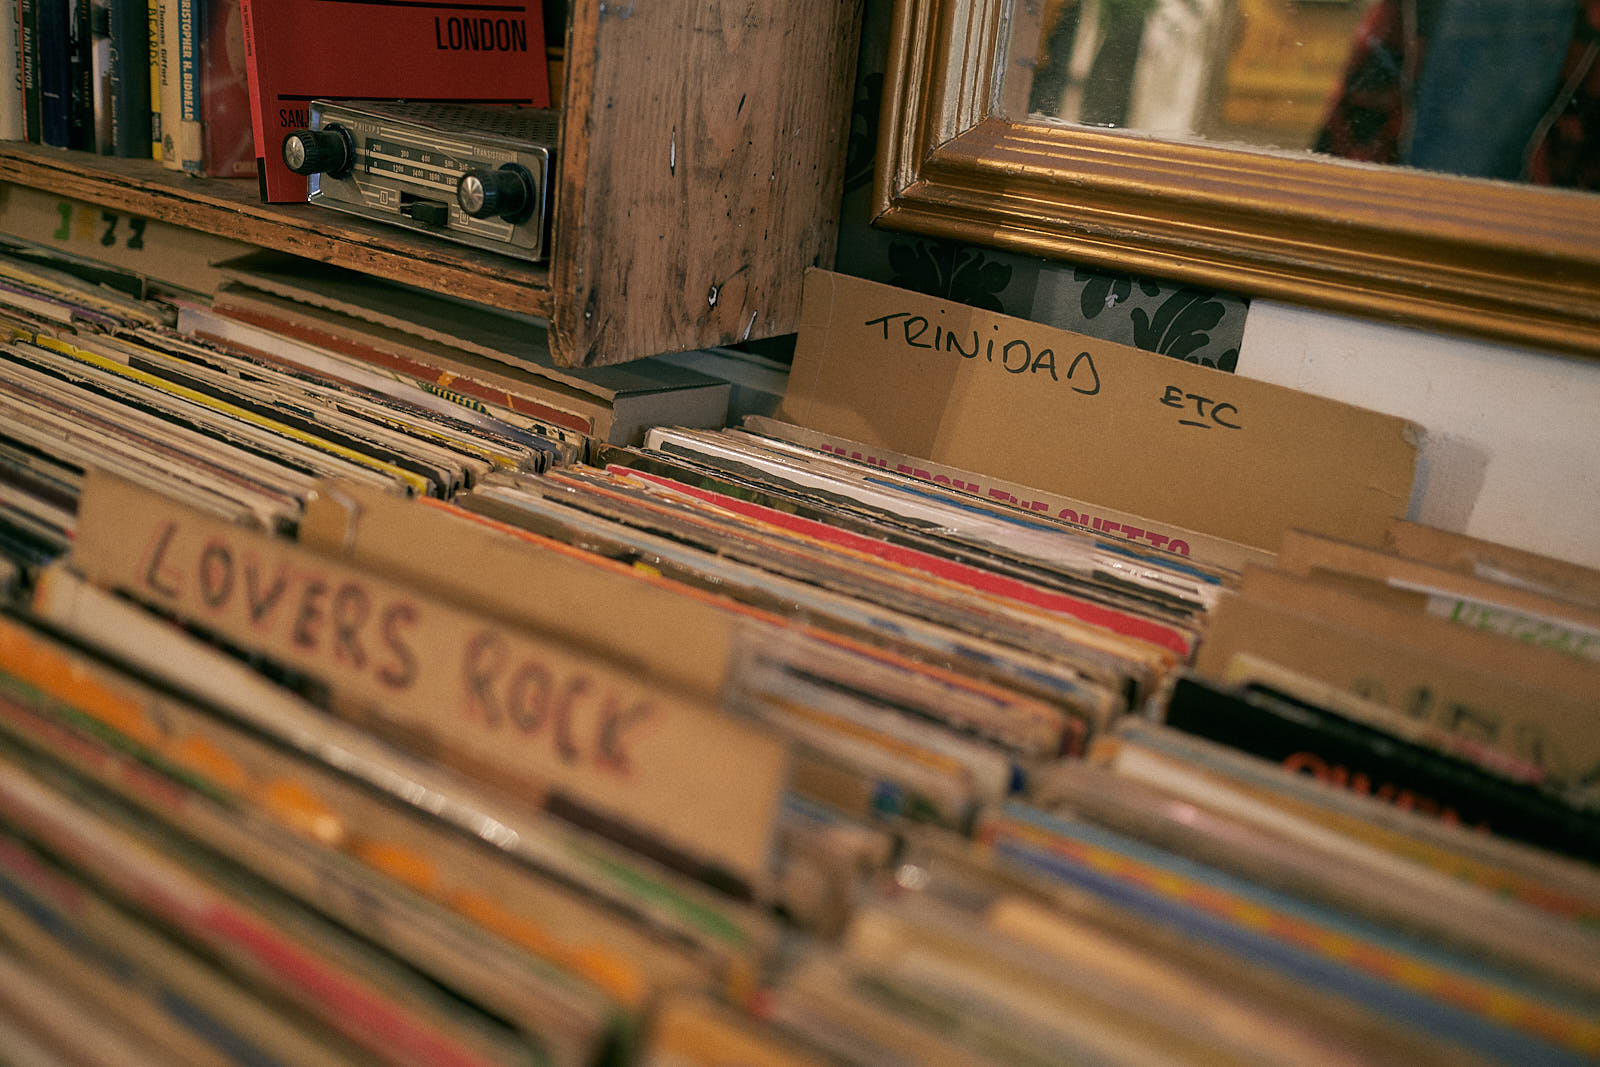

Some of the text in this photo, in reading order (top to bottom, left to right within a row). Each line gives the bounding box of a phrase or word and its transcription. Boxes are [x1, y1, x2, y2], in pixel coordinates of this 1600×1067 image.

[23, 27, 33, 90] RAIN PRYOR
[435, 16, 528, 52] LONDON
[160, 48, 169, 87] Gifford
[183, 72, 194, 121] BIDMEAD
[865, 309, 1242, 430] TRINIDAD ETC
[141, 520, 662, 779] LOVERS ROCK
